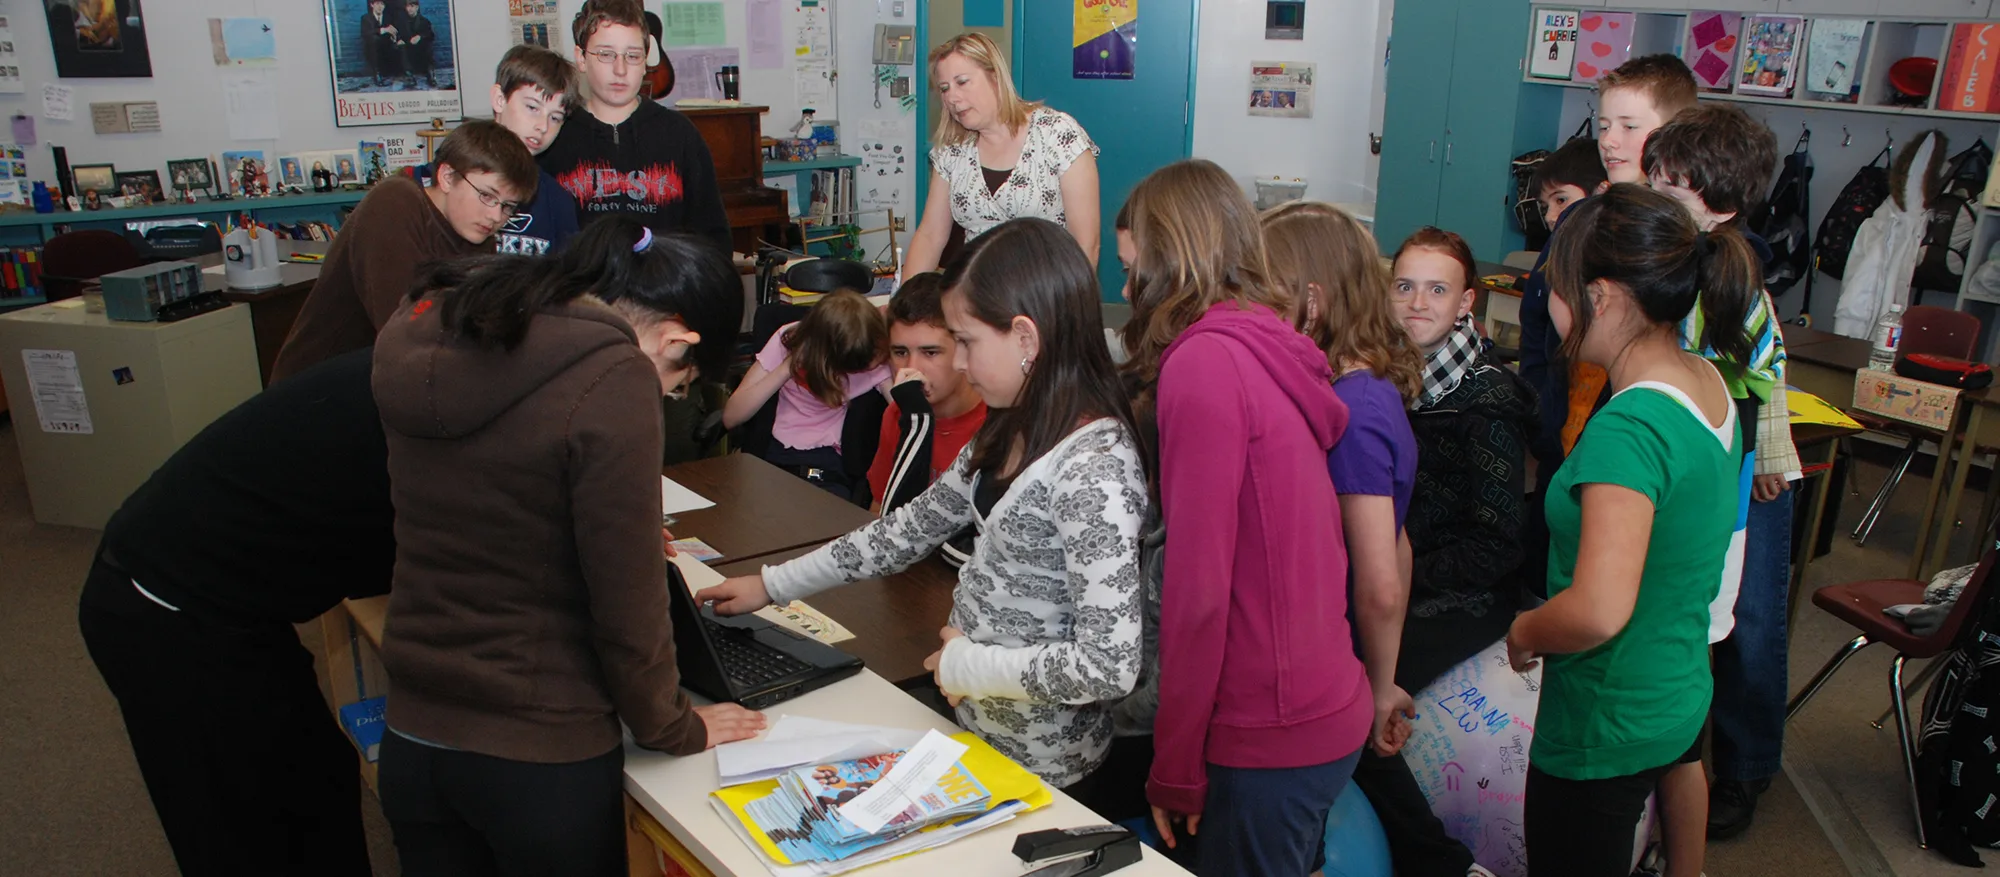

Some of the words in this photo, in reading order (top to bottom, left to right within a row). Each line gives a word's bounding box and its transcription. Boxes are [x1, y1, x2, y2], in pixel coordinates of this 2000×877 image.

[1545, 15, 1574, 28] ALEX'S
[1543, 30, 1577, 42] CUBBIE
[1963, 24, 1995, 107] CALEB
[338, 98, 395, 120] BEATLES
[386, 138, 405, 147] BBEY
[388, 147, 404, 156] OAD
[587, 202, 621, 212] FORTY
[626, 202, 657, 214] NINE
[1438, 695, 1479, 733] LOW
[1451, 679, 1511, 736] BRIANNA
[356, 713, 385, 728] Dict
